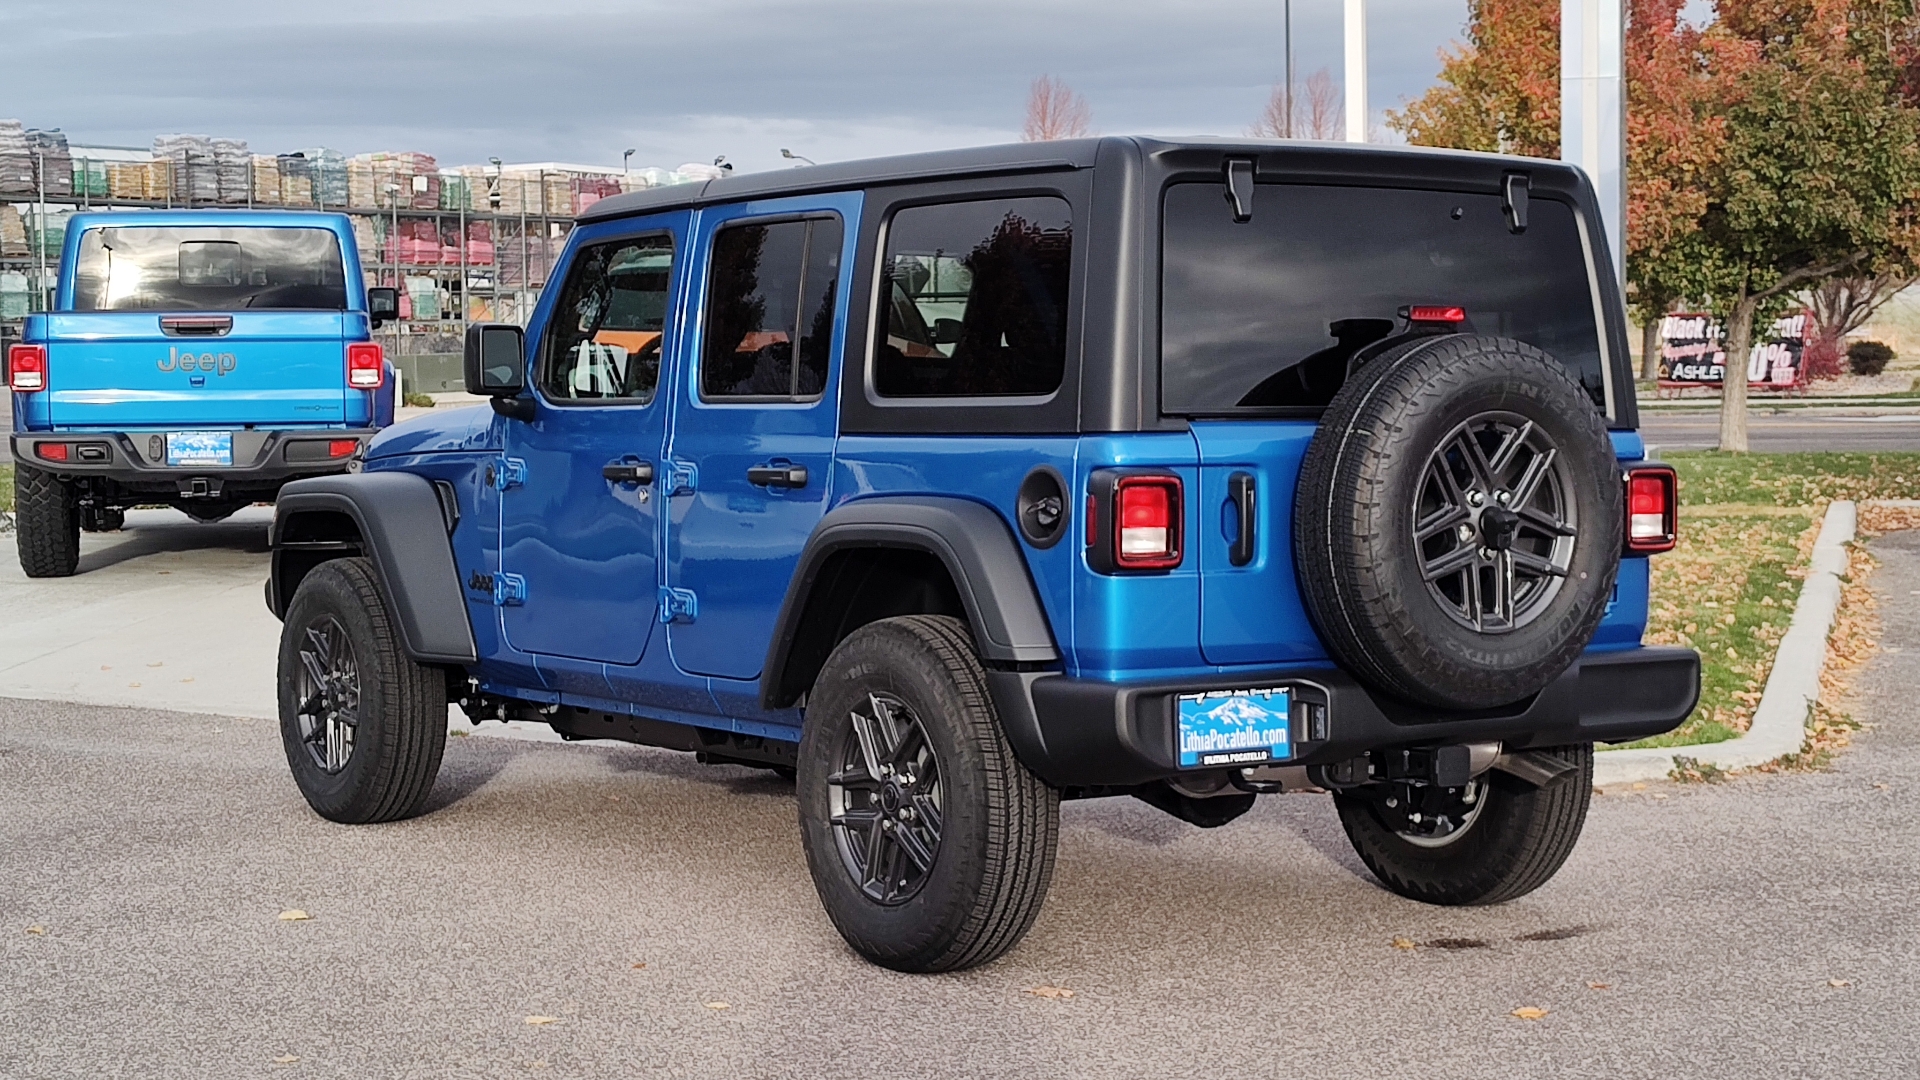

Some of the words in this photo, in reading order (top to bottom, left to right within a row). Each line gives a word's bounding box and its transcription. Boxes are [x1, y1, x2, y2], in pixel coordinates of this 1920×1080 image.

[1661, 316, 1706, 339] Black
[157, 346, 236, 376] Jeep
[1747, 342, 1792, 382] 0%
[468, 569, 494, 596] Jeep
[1180, 726, 1287, 752] LithiaPocatello.com
